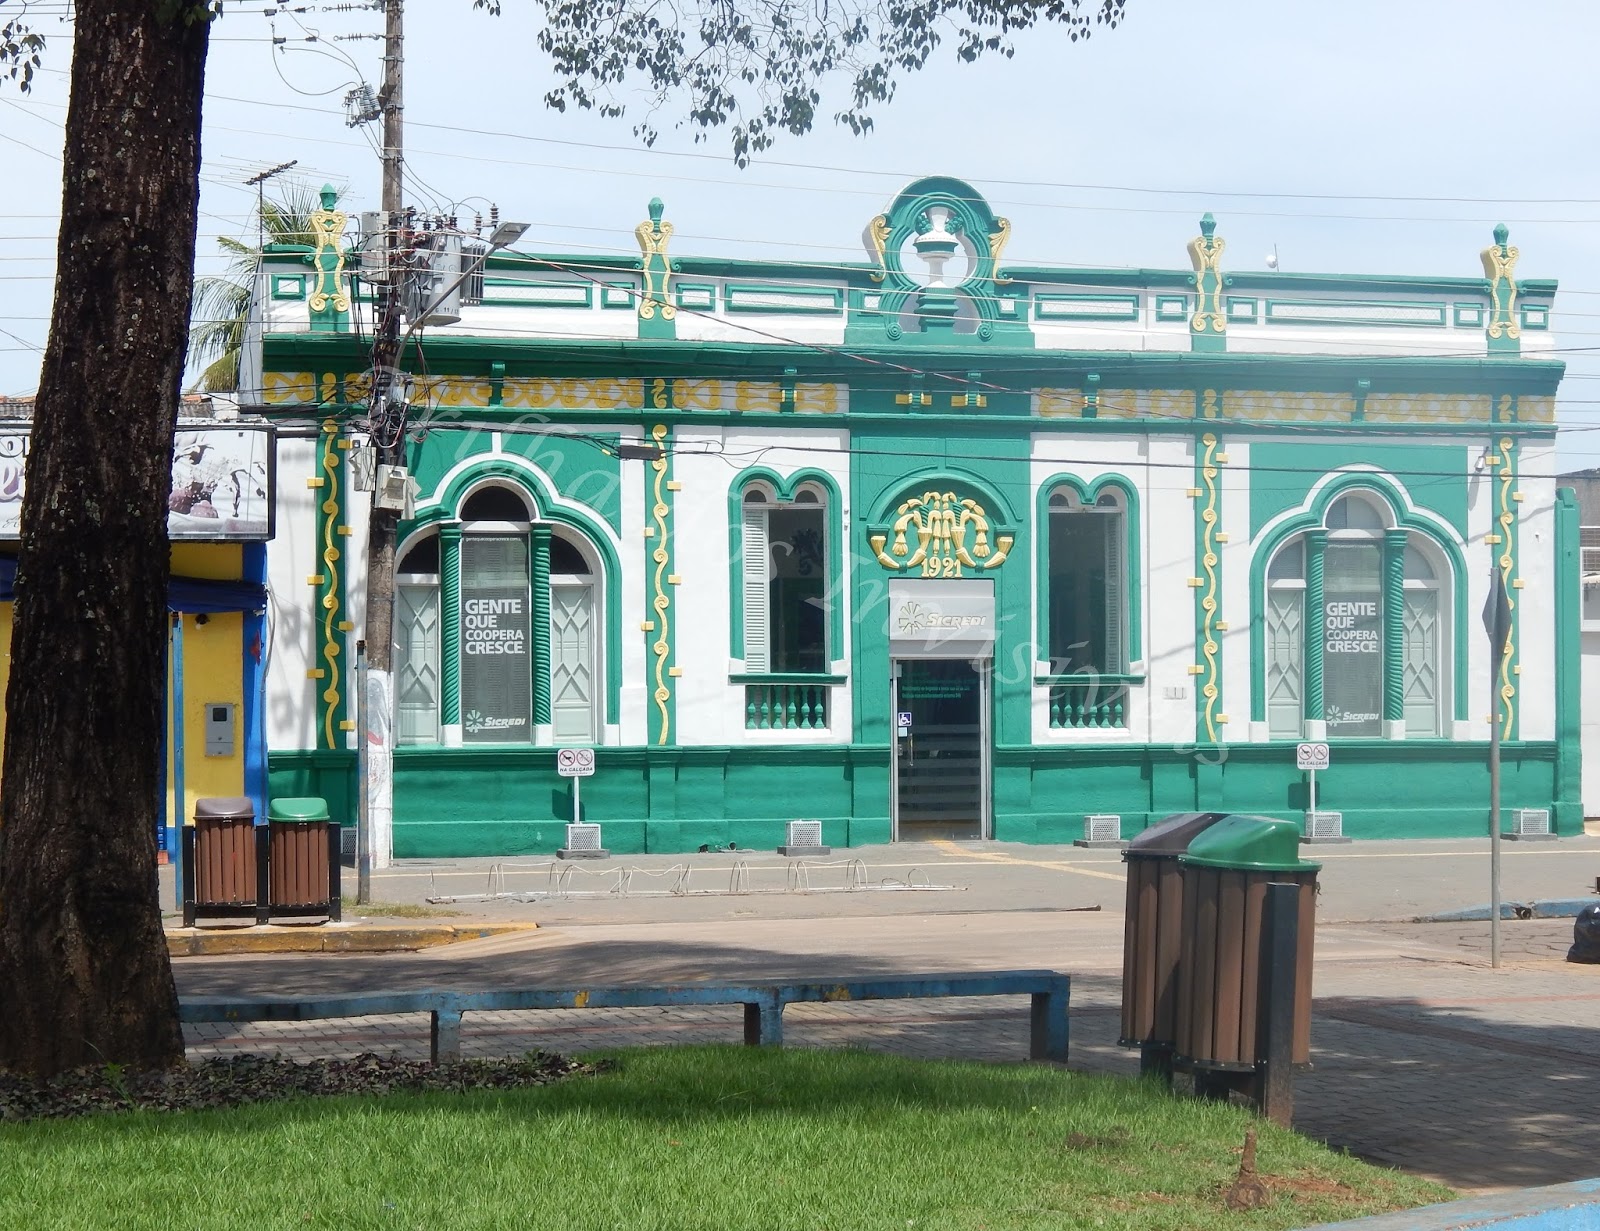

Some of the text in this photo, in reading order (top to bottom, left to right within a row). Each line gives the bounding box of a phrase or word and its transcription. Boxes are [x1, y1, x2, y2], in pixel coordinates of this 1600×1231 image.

[921, 556, 963, 577] 1921
[465, 599, 522, 614] GENTE
[1326, 602, 1376, 616] GENTE
[465, 615, 497, 629] QUE
[1326, 616, 1355, 629] QUE
[465, 629, 524, 640] COOPERA
[1326, 630, 1378, 640] COOPERA
[465, 641, 526, 655] CRESCE.
[1326, 640, 1379, 653] CRESCE.
